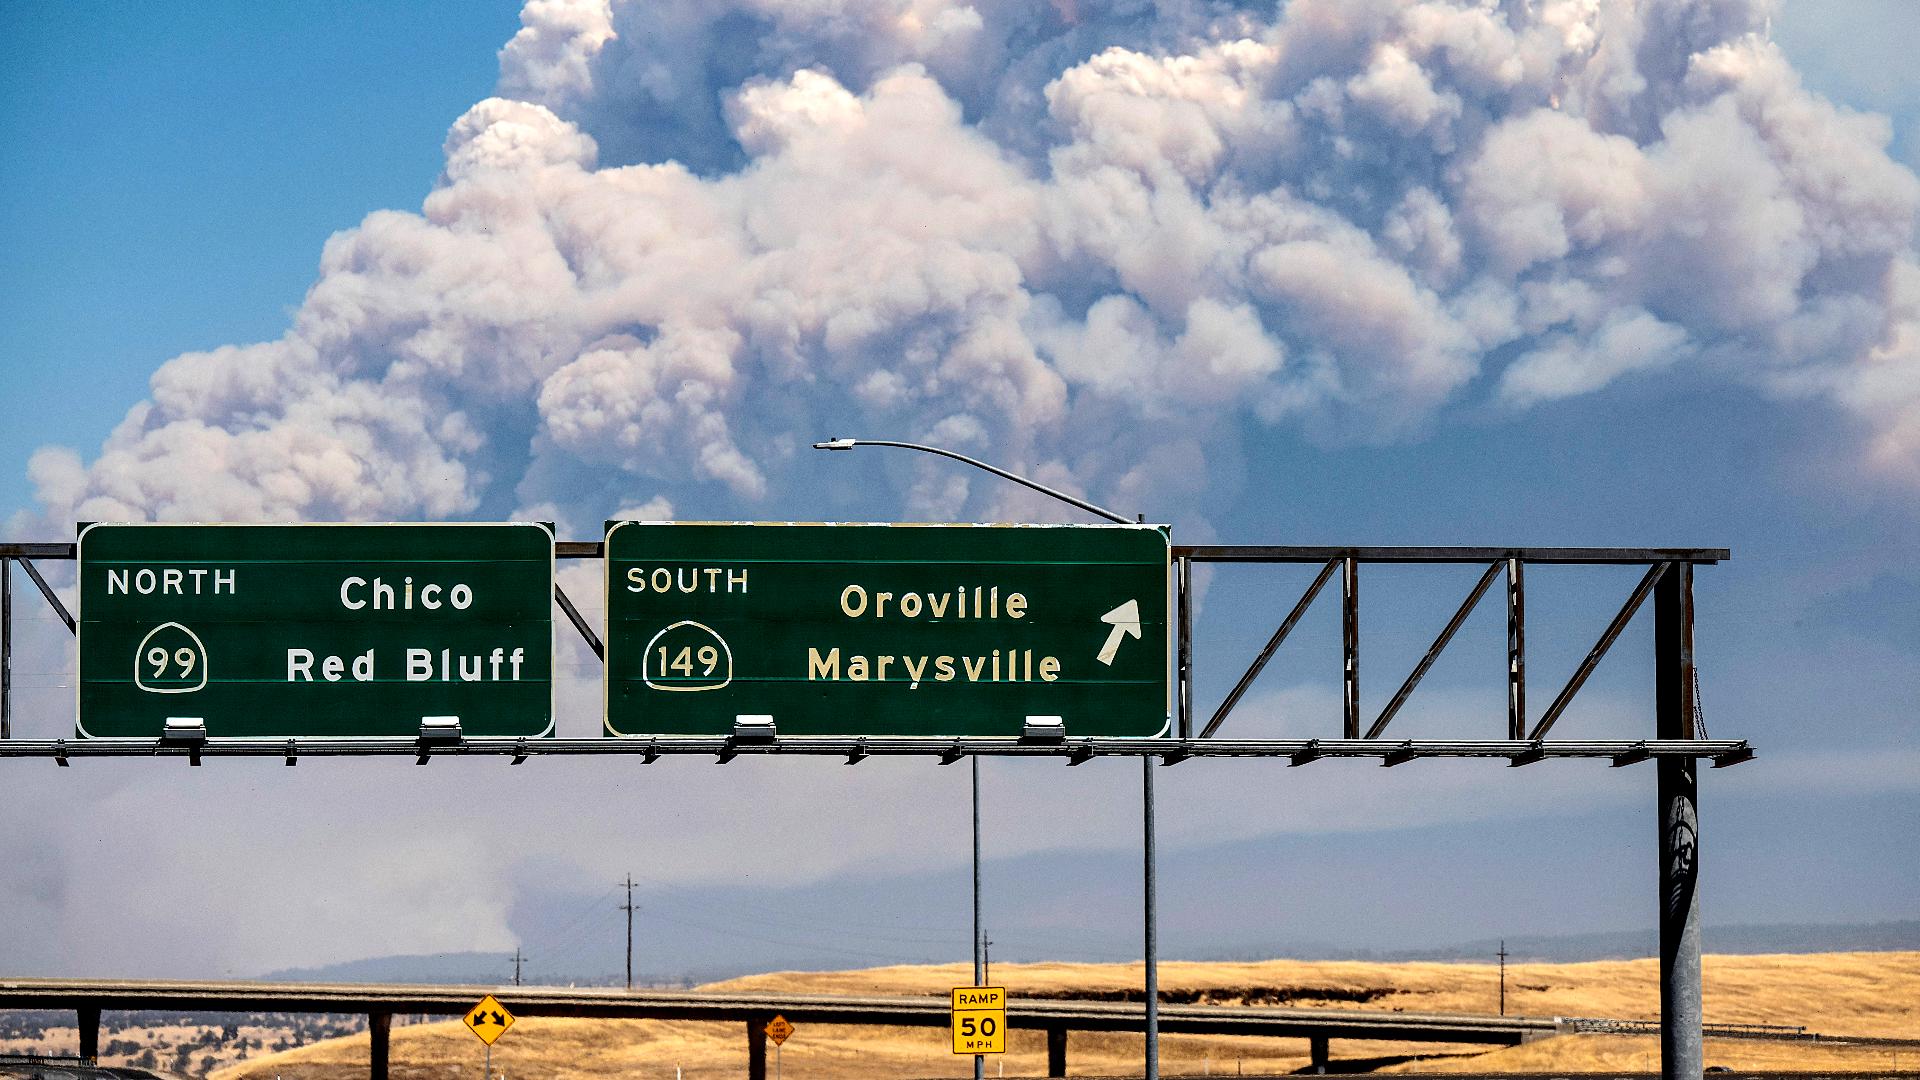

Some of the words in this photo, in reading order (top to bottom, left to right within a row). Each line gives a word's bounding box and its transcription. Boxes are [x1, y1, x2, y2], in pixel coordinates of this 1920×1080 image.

[108, 569, 235, 595] NORTH
[341, 577, 473, 610] Chico
[627, 568, 748, 594] SOUTH
[840, 584, 1028, 619] Oroville
[148, 647, 196, 679] 99
[287, 648, 375, 682] Red
[406, 648, 524, 682] Bluff
[658, 646, 718, 677] 149
[808, 648, 1061, 690] Marysville
[960, 993, 998, 1004] RAMP
[961, 1017, 996, 1037] 50
[966, 1040, 992, 1048] MPH
